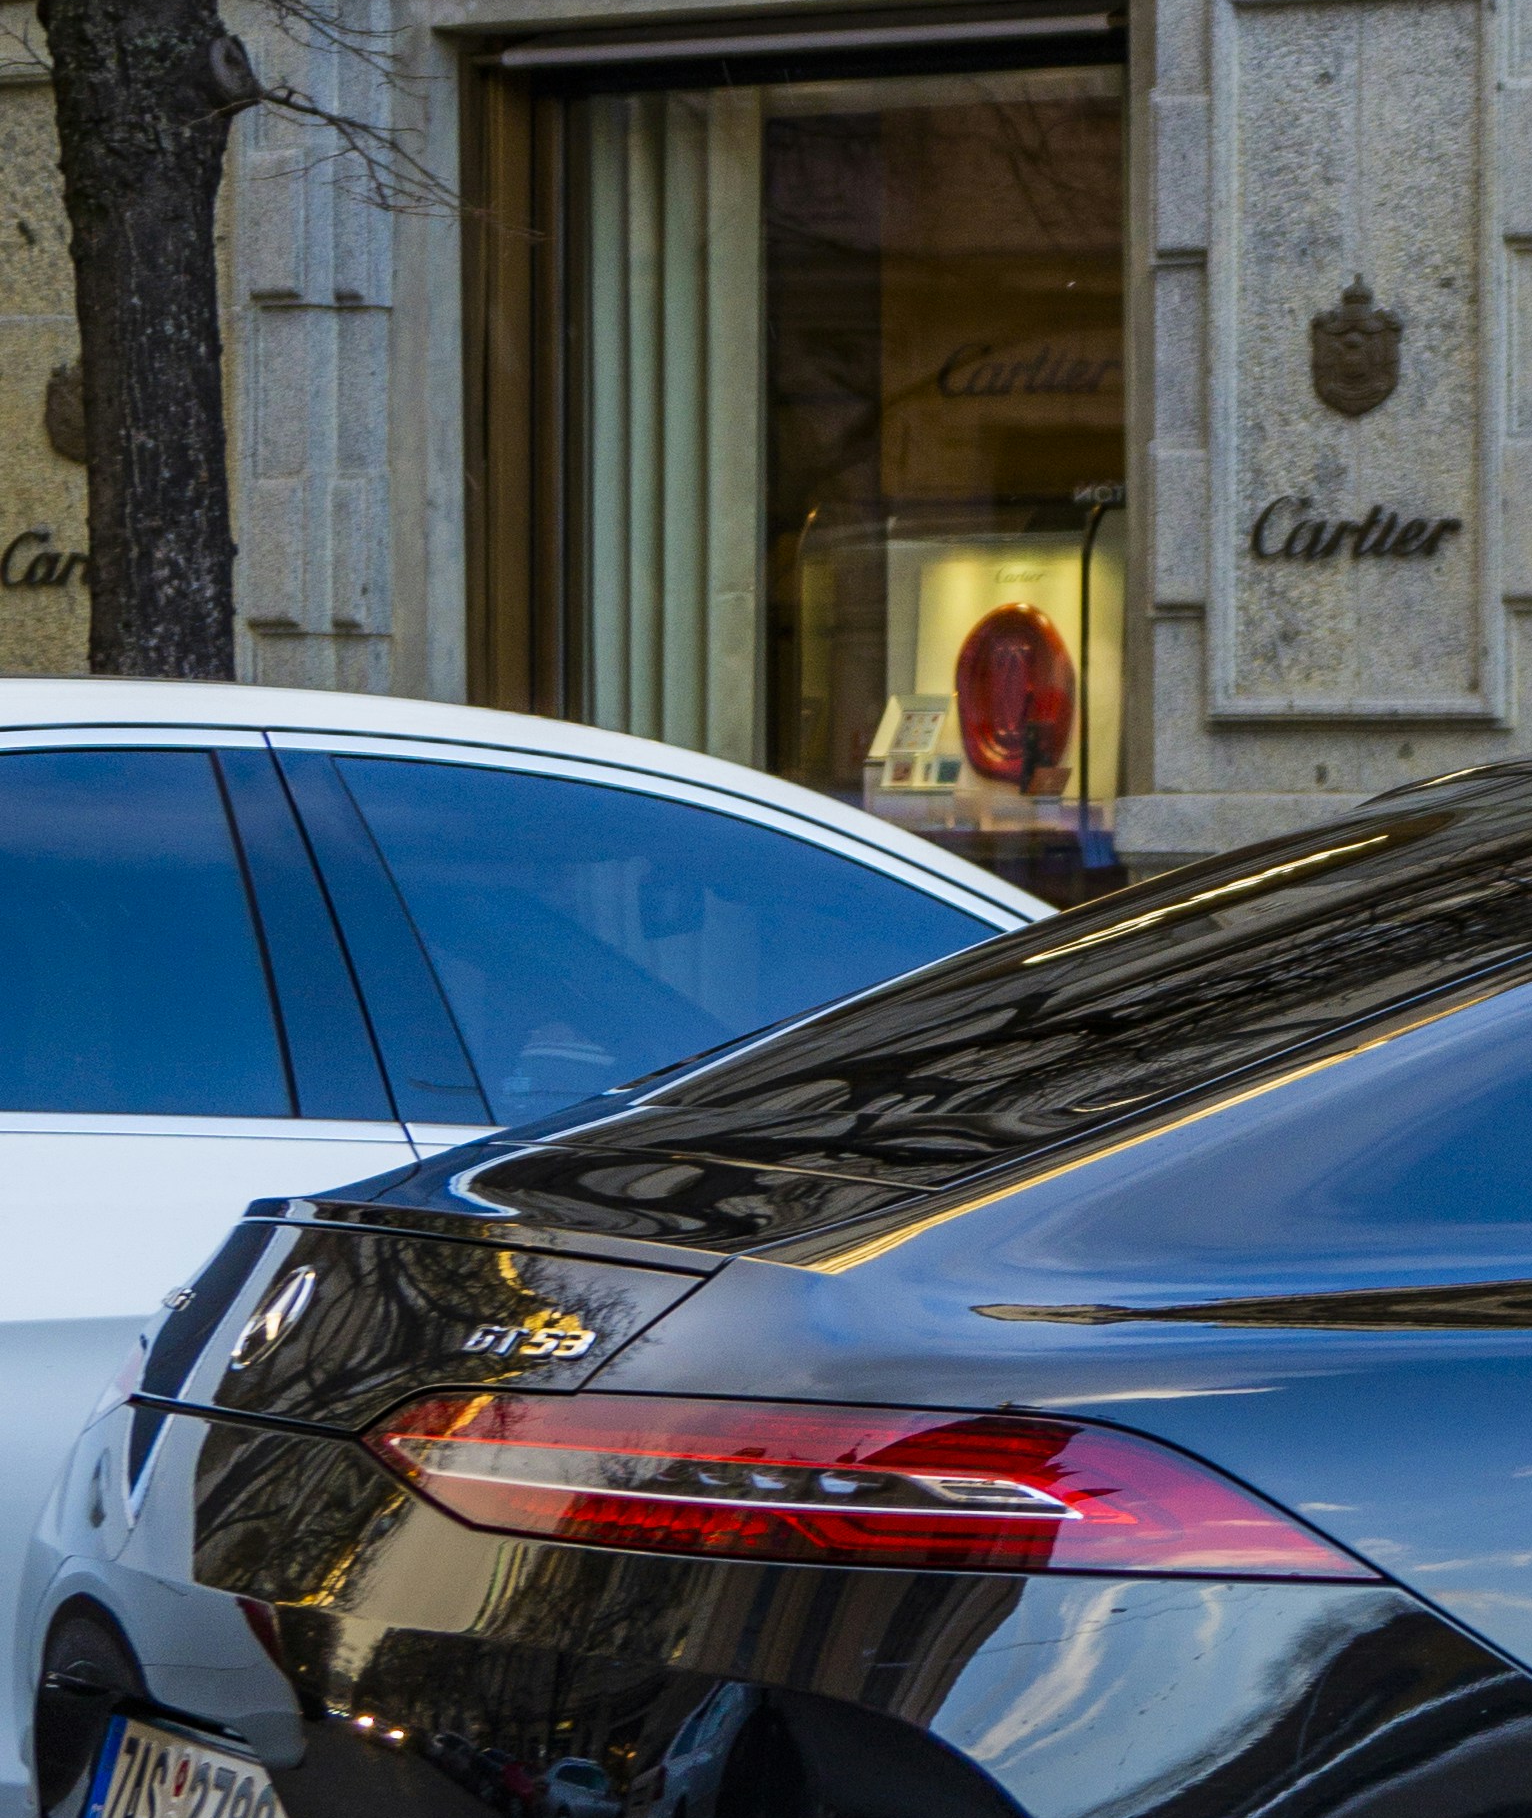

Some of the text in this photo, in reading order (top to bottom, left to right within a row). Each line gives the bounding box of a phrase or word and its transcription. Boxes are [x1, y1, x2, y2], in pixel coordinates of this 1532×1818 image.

[937, 343, 1123, 399] Cartier
[1252, 495, 1463, 562] Cartier
[2, 531, 91, 589] Car
[462, 1324, 597, 1360] GT 53
